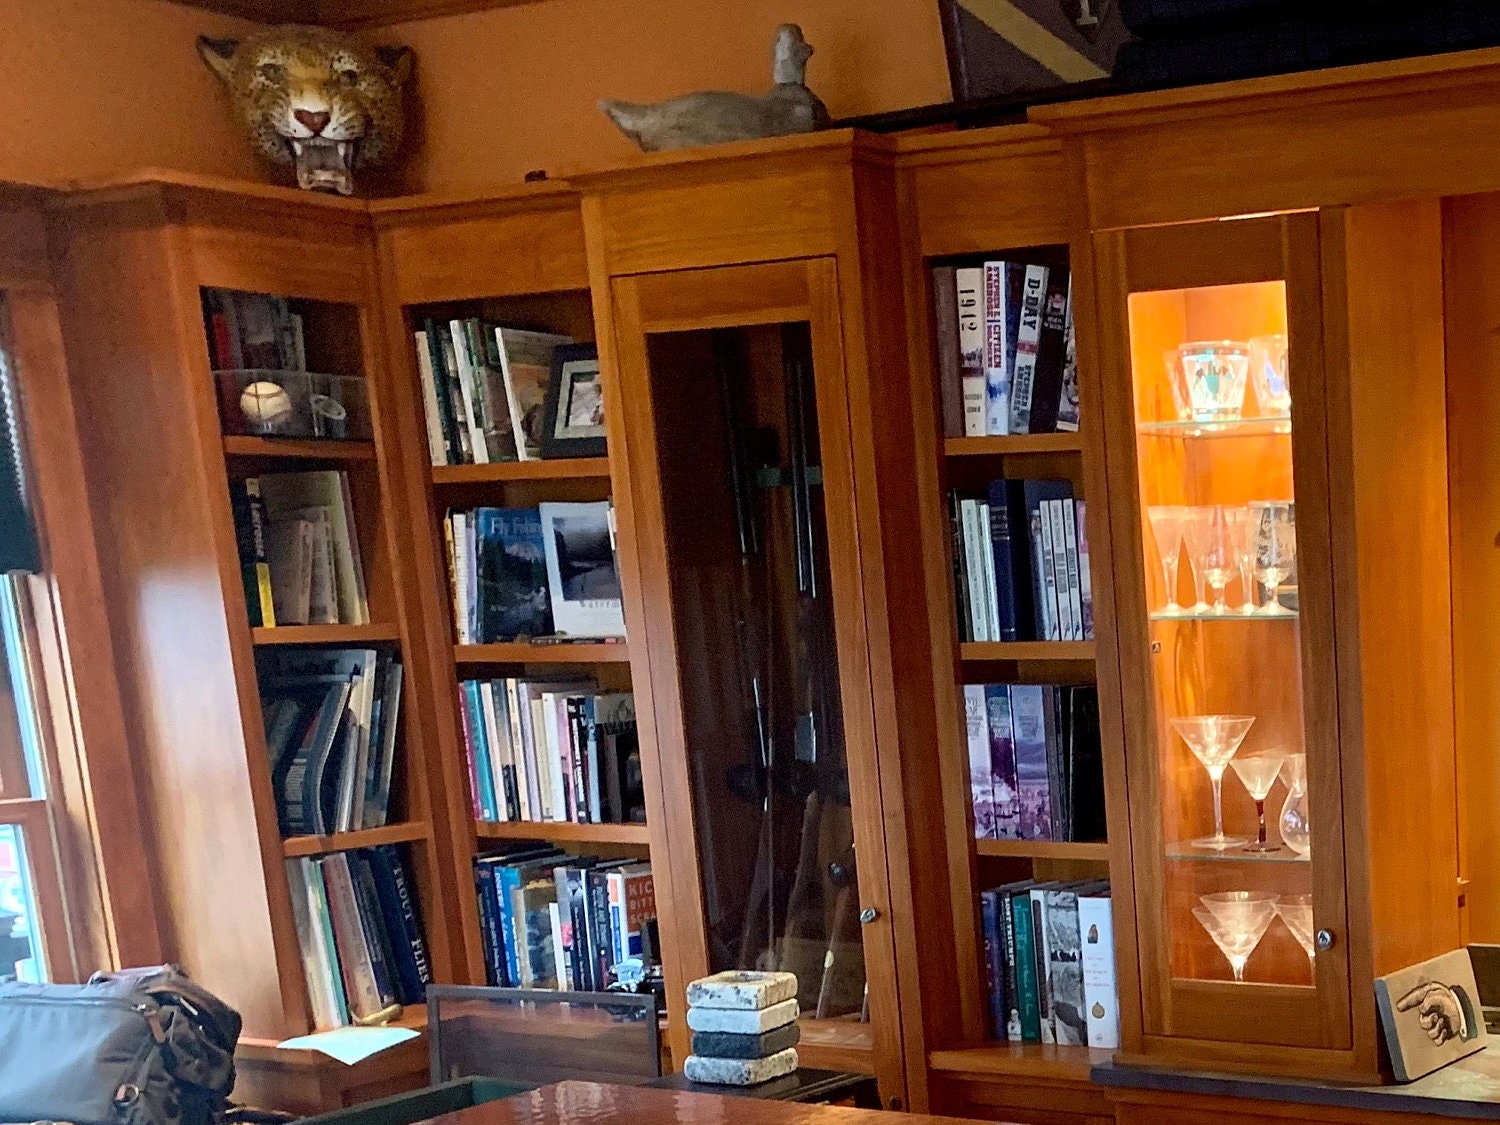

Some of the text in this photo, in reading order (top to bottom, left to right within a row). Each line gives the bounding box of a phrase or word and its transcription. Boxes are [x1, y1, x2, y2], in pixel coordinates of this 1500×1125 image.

[1023, 278, 1041, 330] D-DAY
[393, 867, 430, 983] TROUT FLIES
